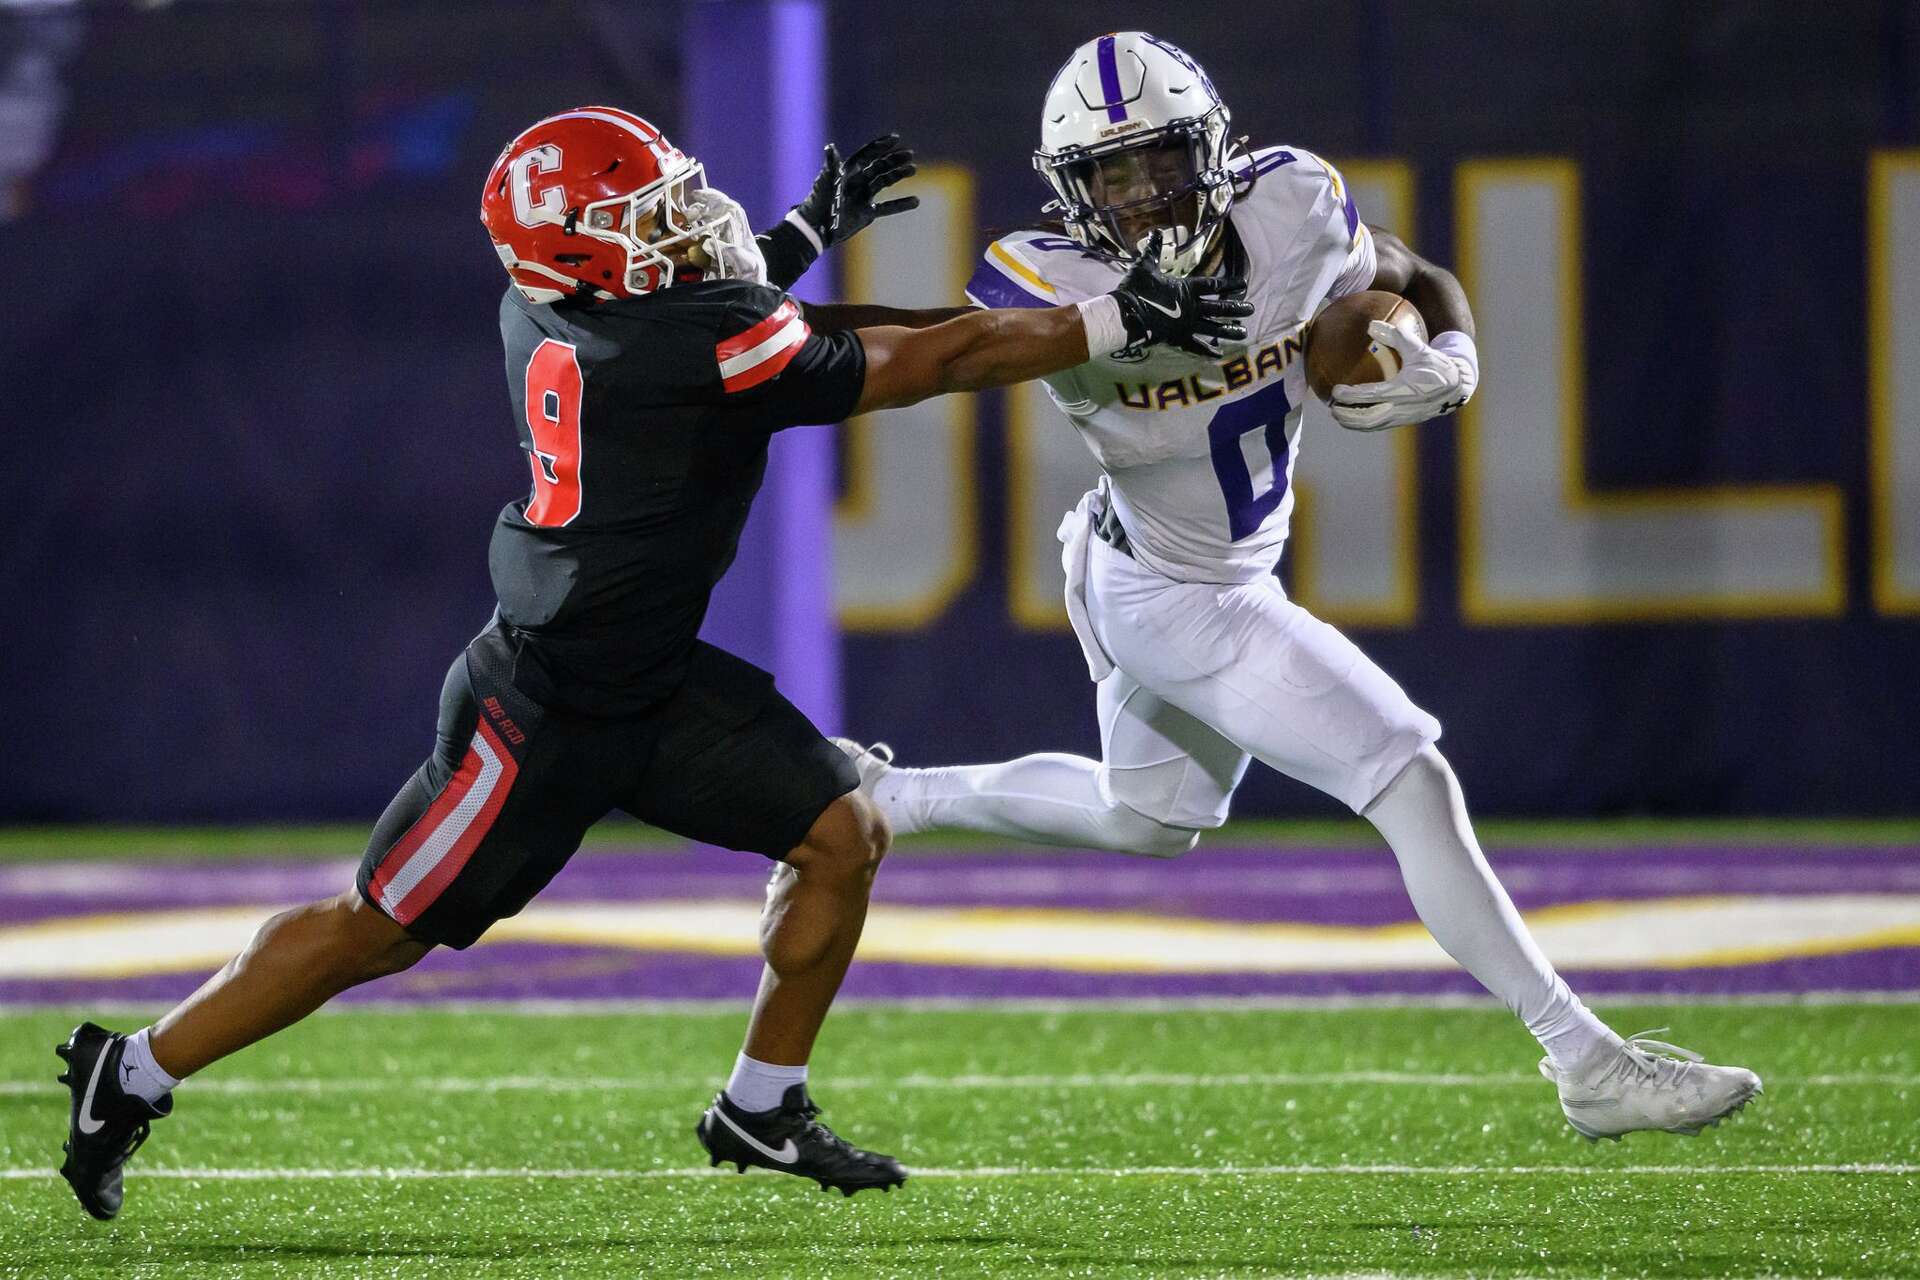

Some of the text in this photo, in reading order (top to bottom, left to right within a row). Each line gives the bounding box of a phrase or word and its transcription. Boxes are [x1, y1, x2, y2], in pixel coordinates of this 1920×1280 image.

[512, 143, 567, 229] C
[1114, 322, 1309, 412] UALBAN
[523, 337, 583, 527] 9
[1207, 377, 1292, 543] 0
[482, 695, 526, 745] BIG RED
